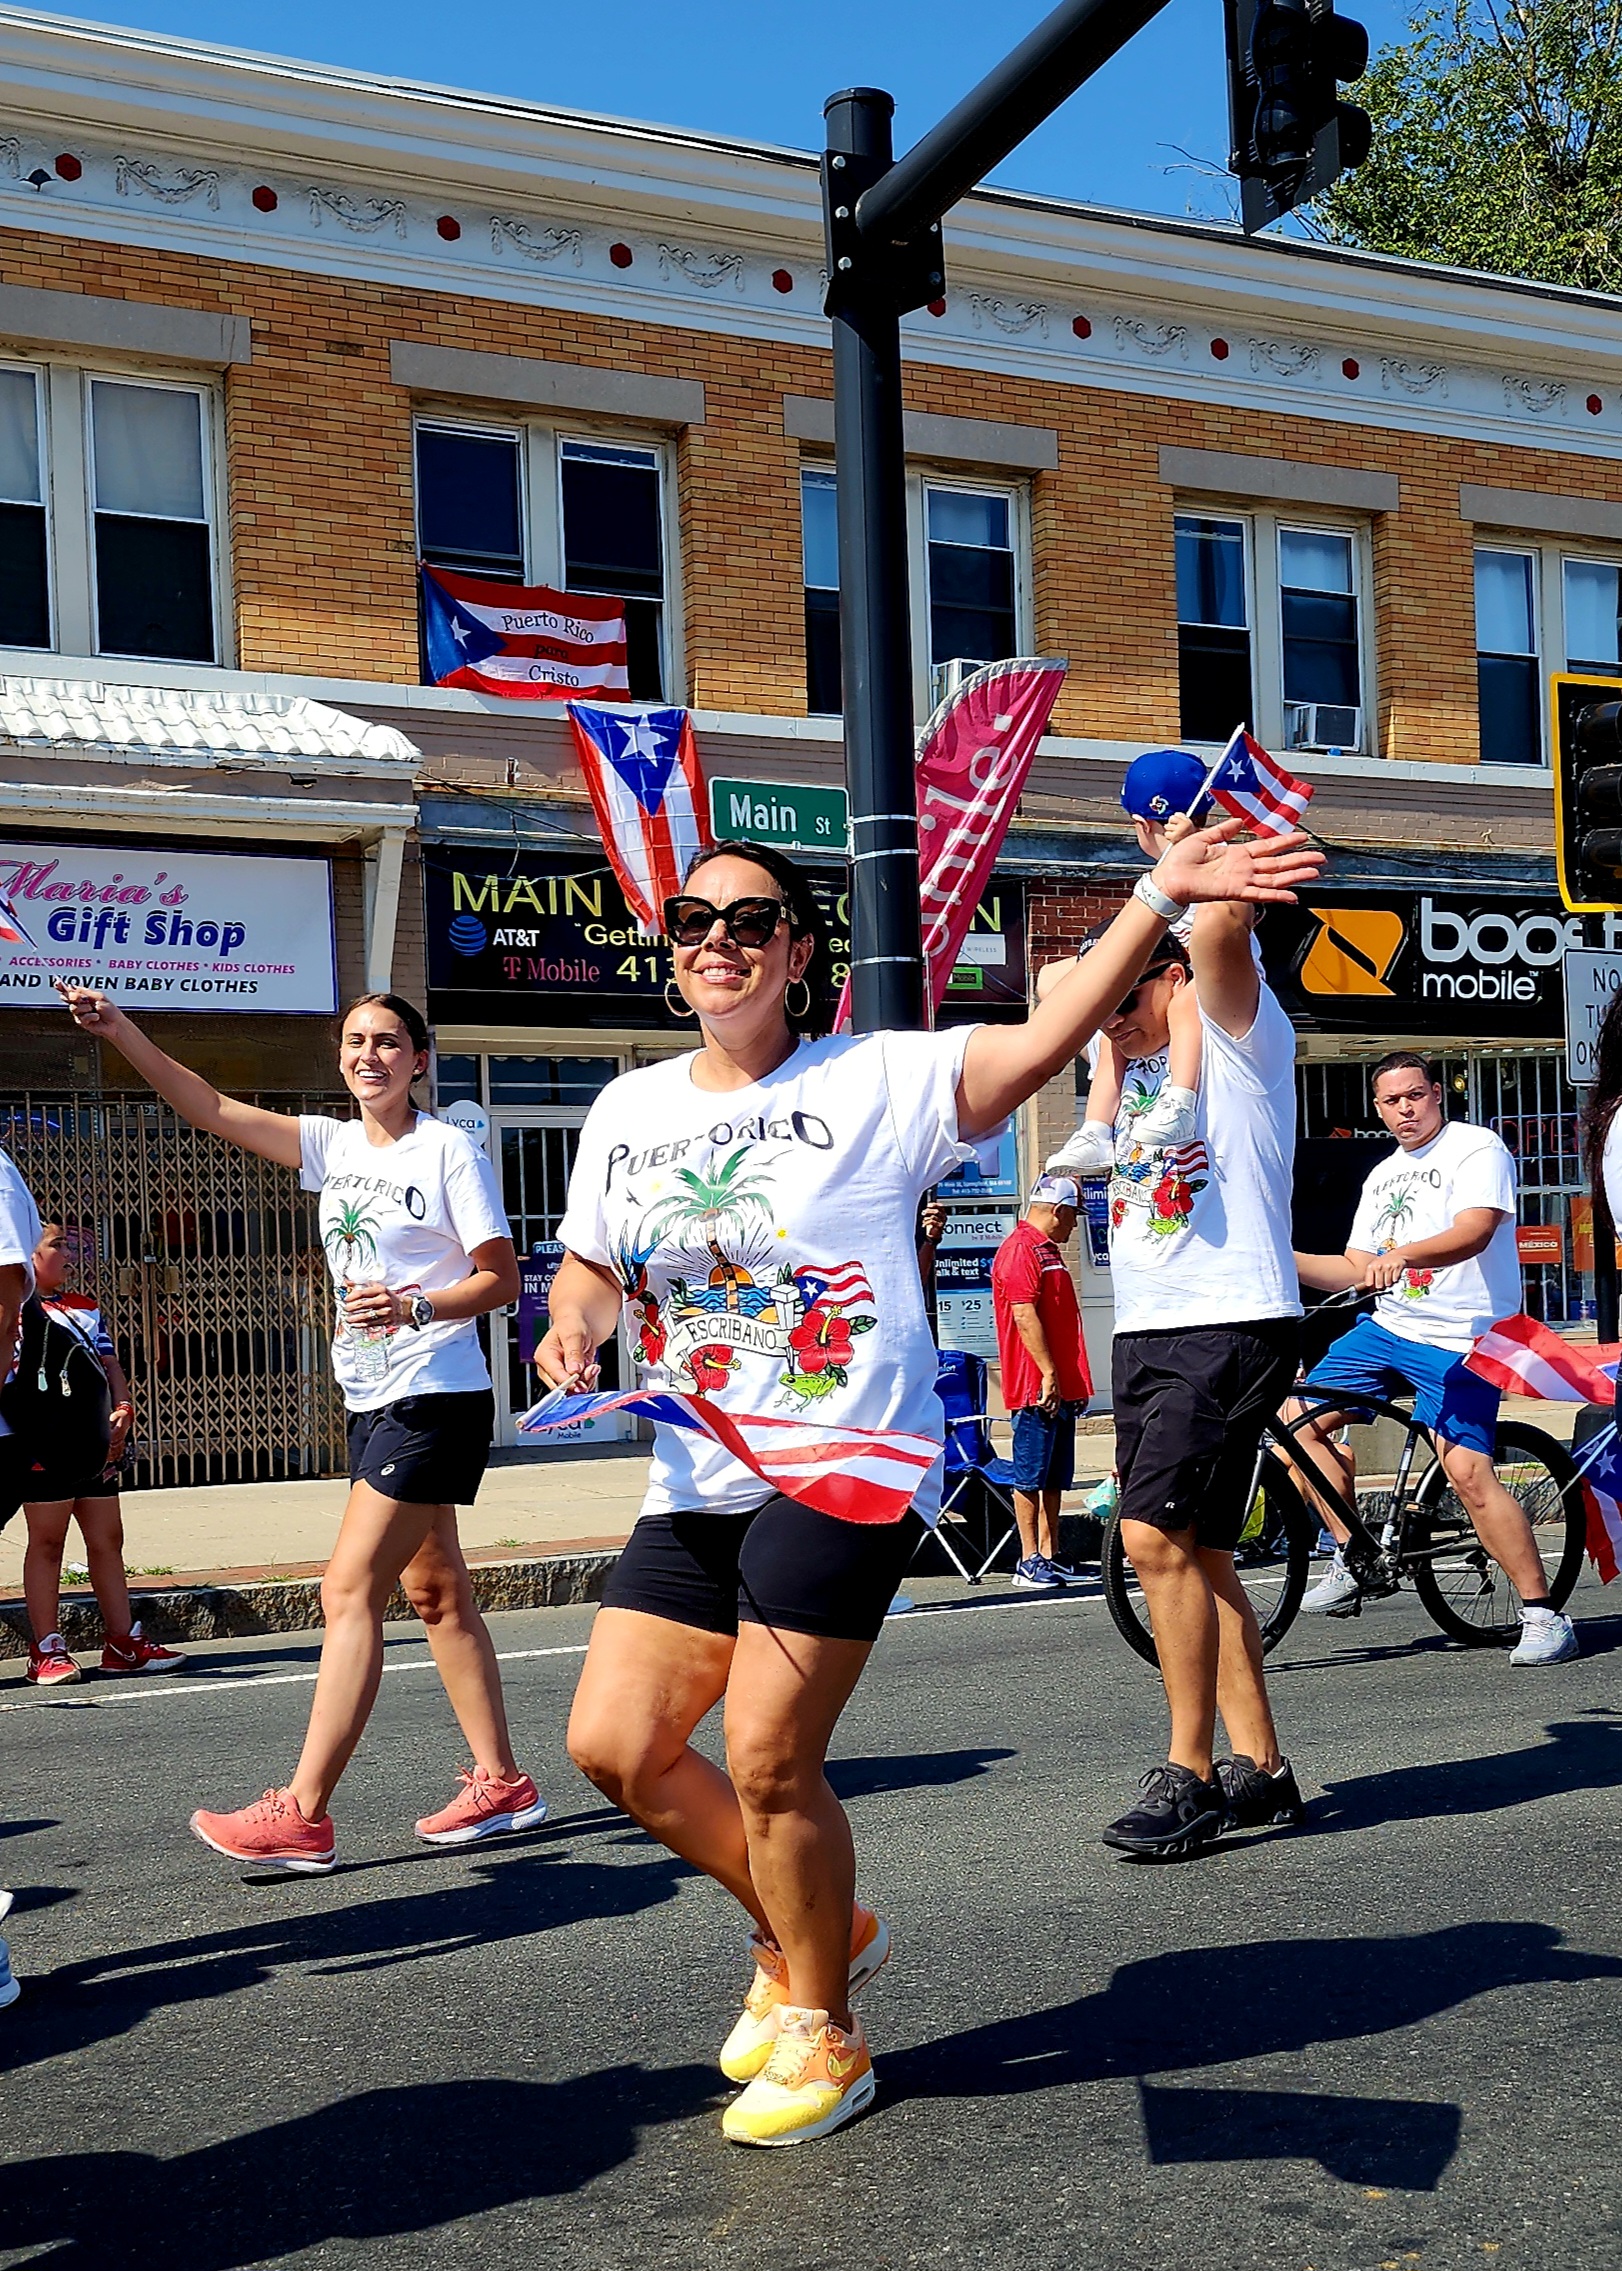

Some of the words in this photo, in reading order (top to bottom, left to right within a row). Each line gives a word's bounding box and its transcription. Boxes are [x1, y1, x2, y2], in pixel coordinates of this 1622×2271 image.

[501, 612, 558, 631] Puerto
[563, 617, 594, 643] Rico
[534, 644, 569, 659] para
[529, 665, 580, 687] Cristo
[730, 793, 798, 833] Main
[814, 816, 832, 835] St
[0, 859, 189, 906] Maria's
[452, 871, 602, 917] MAIN
[47, 906, 132, 950] Gift
[143, 909, 246, 956] Shop
[493, 928, 540, 947] AT&T
[108, 959, 142, 970] BABY
[146, 960, 199, 971] CLOTHES
[212, 962, 240, 973] KIDS
[243, 963, 296, 974] CLOTHES
[526, 957, 600, 983] Mobile
[124, 976, 175, 991] BABY
[180, 978, 258, 994] CLOTHES
[1423, 969, 1537, 1000] mobile
[1593, 967, 1622, 993] NO
[943, 1220, 1003, 1235] onnect
[535, 1244, 565, 1254] PLEAS
[524, 1274, 543, 1282] STAY
[936, 1268, 951, 1277] alk
[961, 1268, 979, 1276] text
[524, 1282, 538, 1294] IN
[685, 1317, 777, 1350] ESCRIBANO
